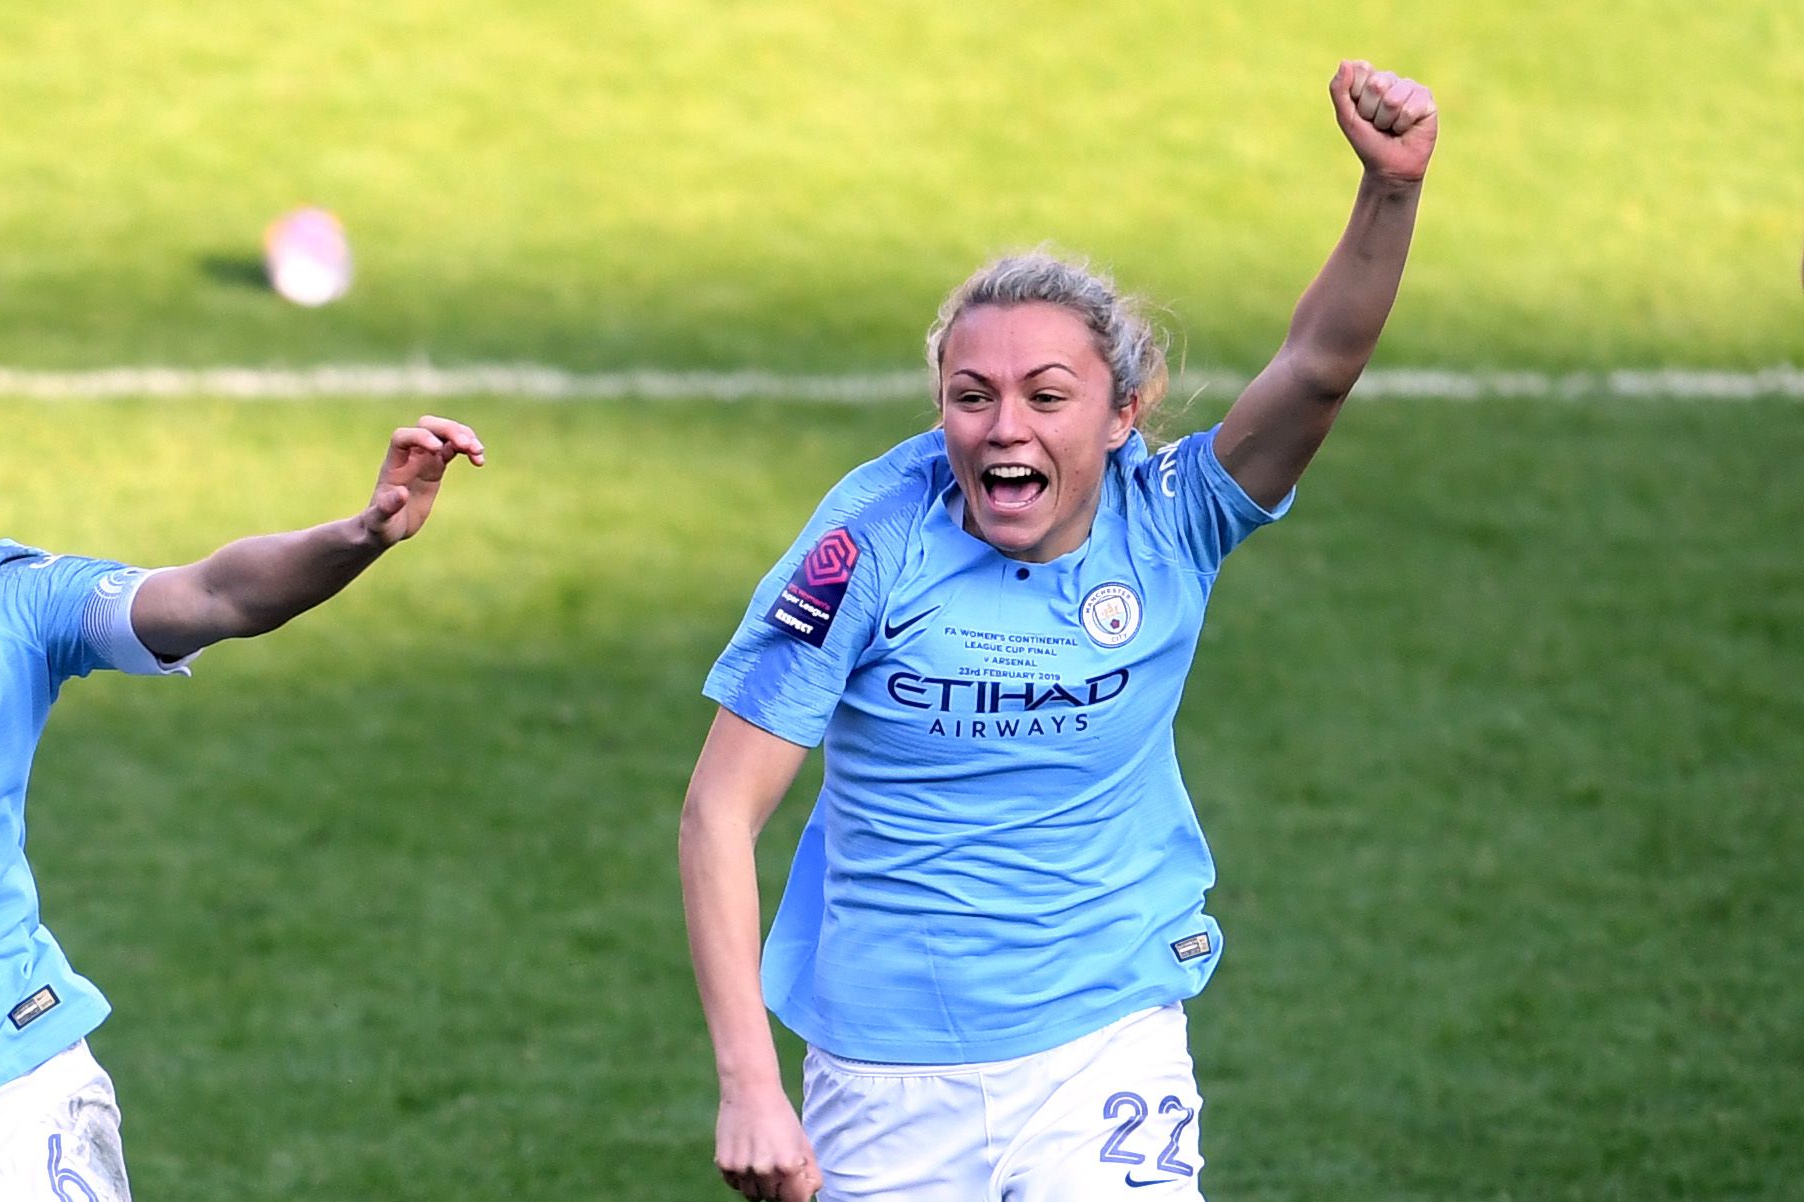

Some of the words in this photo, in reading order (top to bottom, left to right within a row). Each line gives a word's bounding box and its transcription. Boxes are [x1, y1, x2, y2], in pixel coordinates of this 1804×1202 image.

[775, 608, 814, 635] RESPECT
[944, 627, 956, 636] FA
[960, 628, 1005, 641] WOMEN'S
[1008, 634, 1078, 647] CONTINENTAL
[964, 641, 1003, 652] LEAGUE
[1005, 645, 1025, 654] CUP
[1028, 647, 1057, 657] FINAL
[992, 656, 1038, 667] ARSENAL
[958, 667, 981, 677] 23rd
[983, 669, 1036, 680] FEBRUARY
[1038, 672, 1061, 681] 2019
[887, 668, 1130, 714] ETIHAD
[928, 713, 1088, 739] AIRWAYS
[1100, 1091, 1194, 1177] 22
